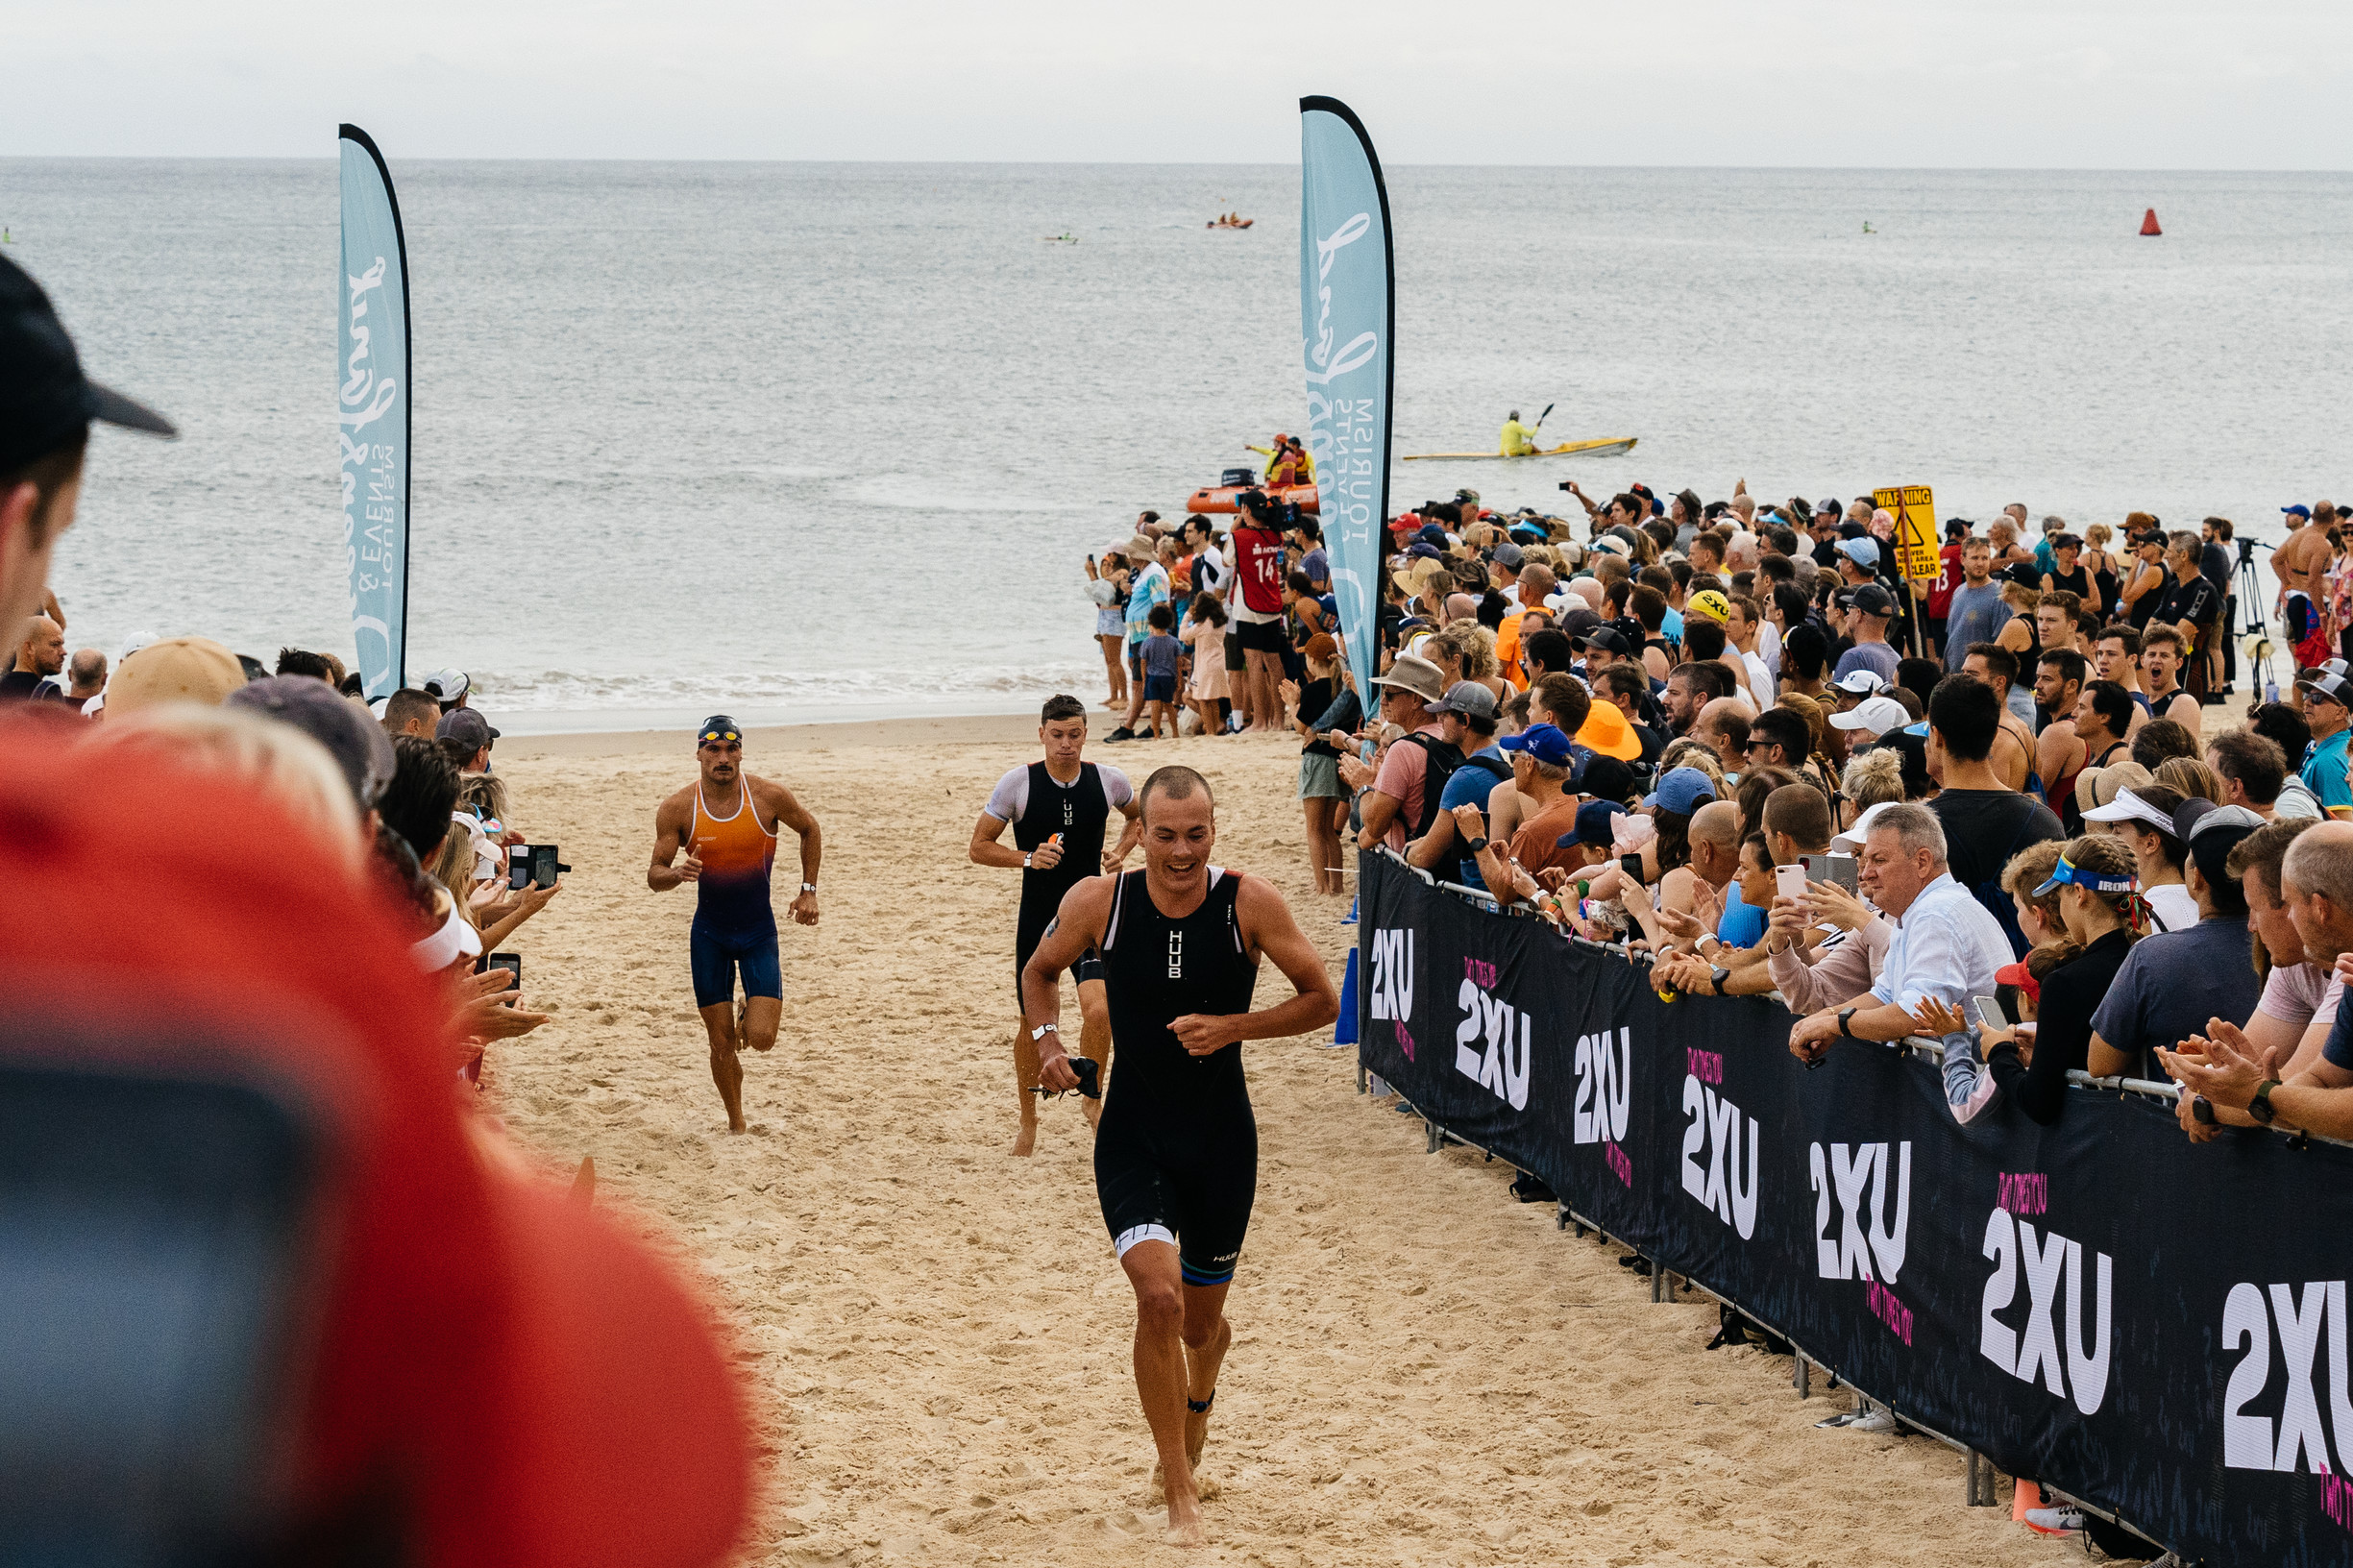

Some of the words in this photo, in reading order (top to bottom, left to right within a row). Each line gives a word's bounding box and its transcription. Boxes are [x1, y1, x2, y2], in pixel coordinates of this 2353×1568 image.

[1702, 594, 1729, 616] 2XU
[1064, 797, 1073, 826] UUB
[1167, 930, 1183, 979] HUUB
[1372, 929, 1413, 1023] 2XU
[1456, 978, 1530, 1112] 2XU
[1575, 1027, 1630, 1144] 2XU
[1681, 1074, 1758, 1240] 2XU
[1810, 1140, 1911, 1285] 2XU
[1980, 1207, 2112, 1415] 2XU
[2319, 1460, 2342, 1526] TWO
